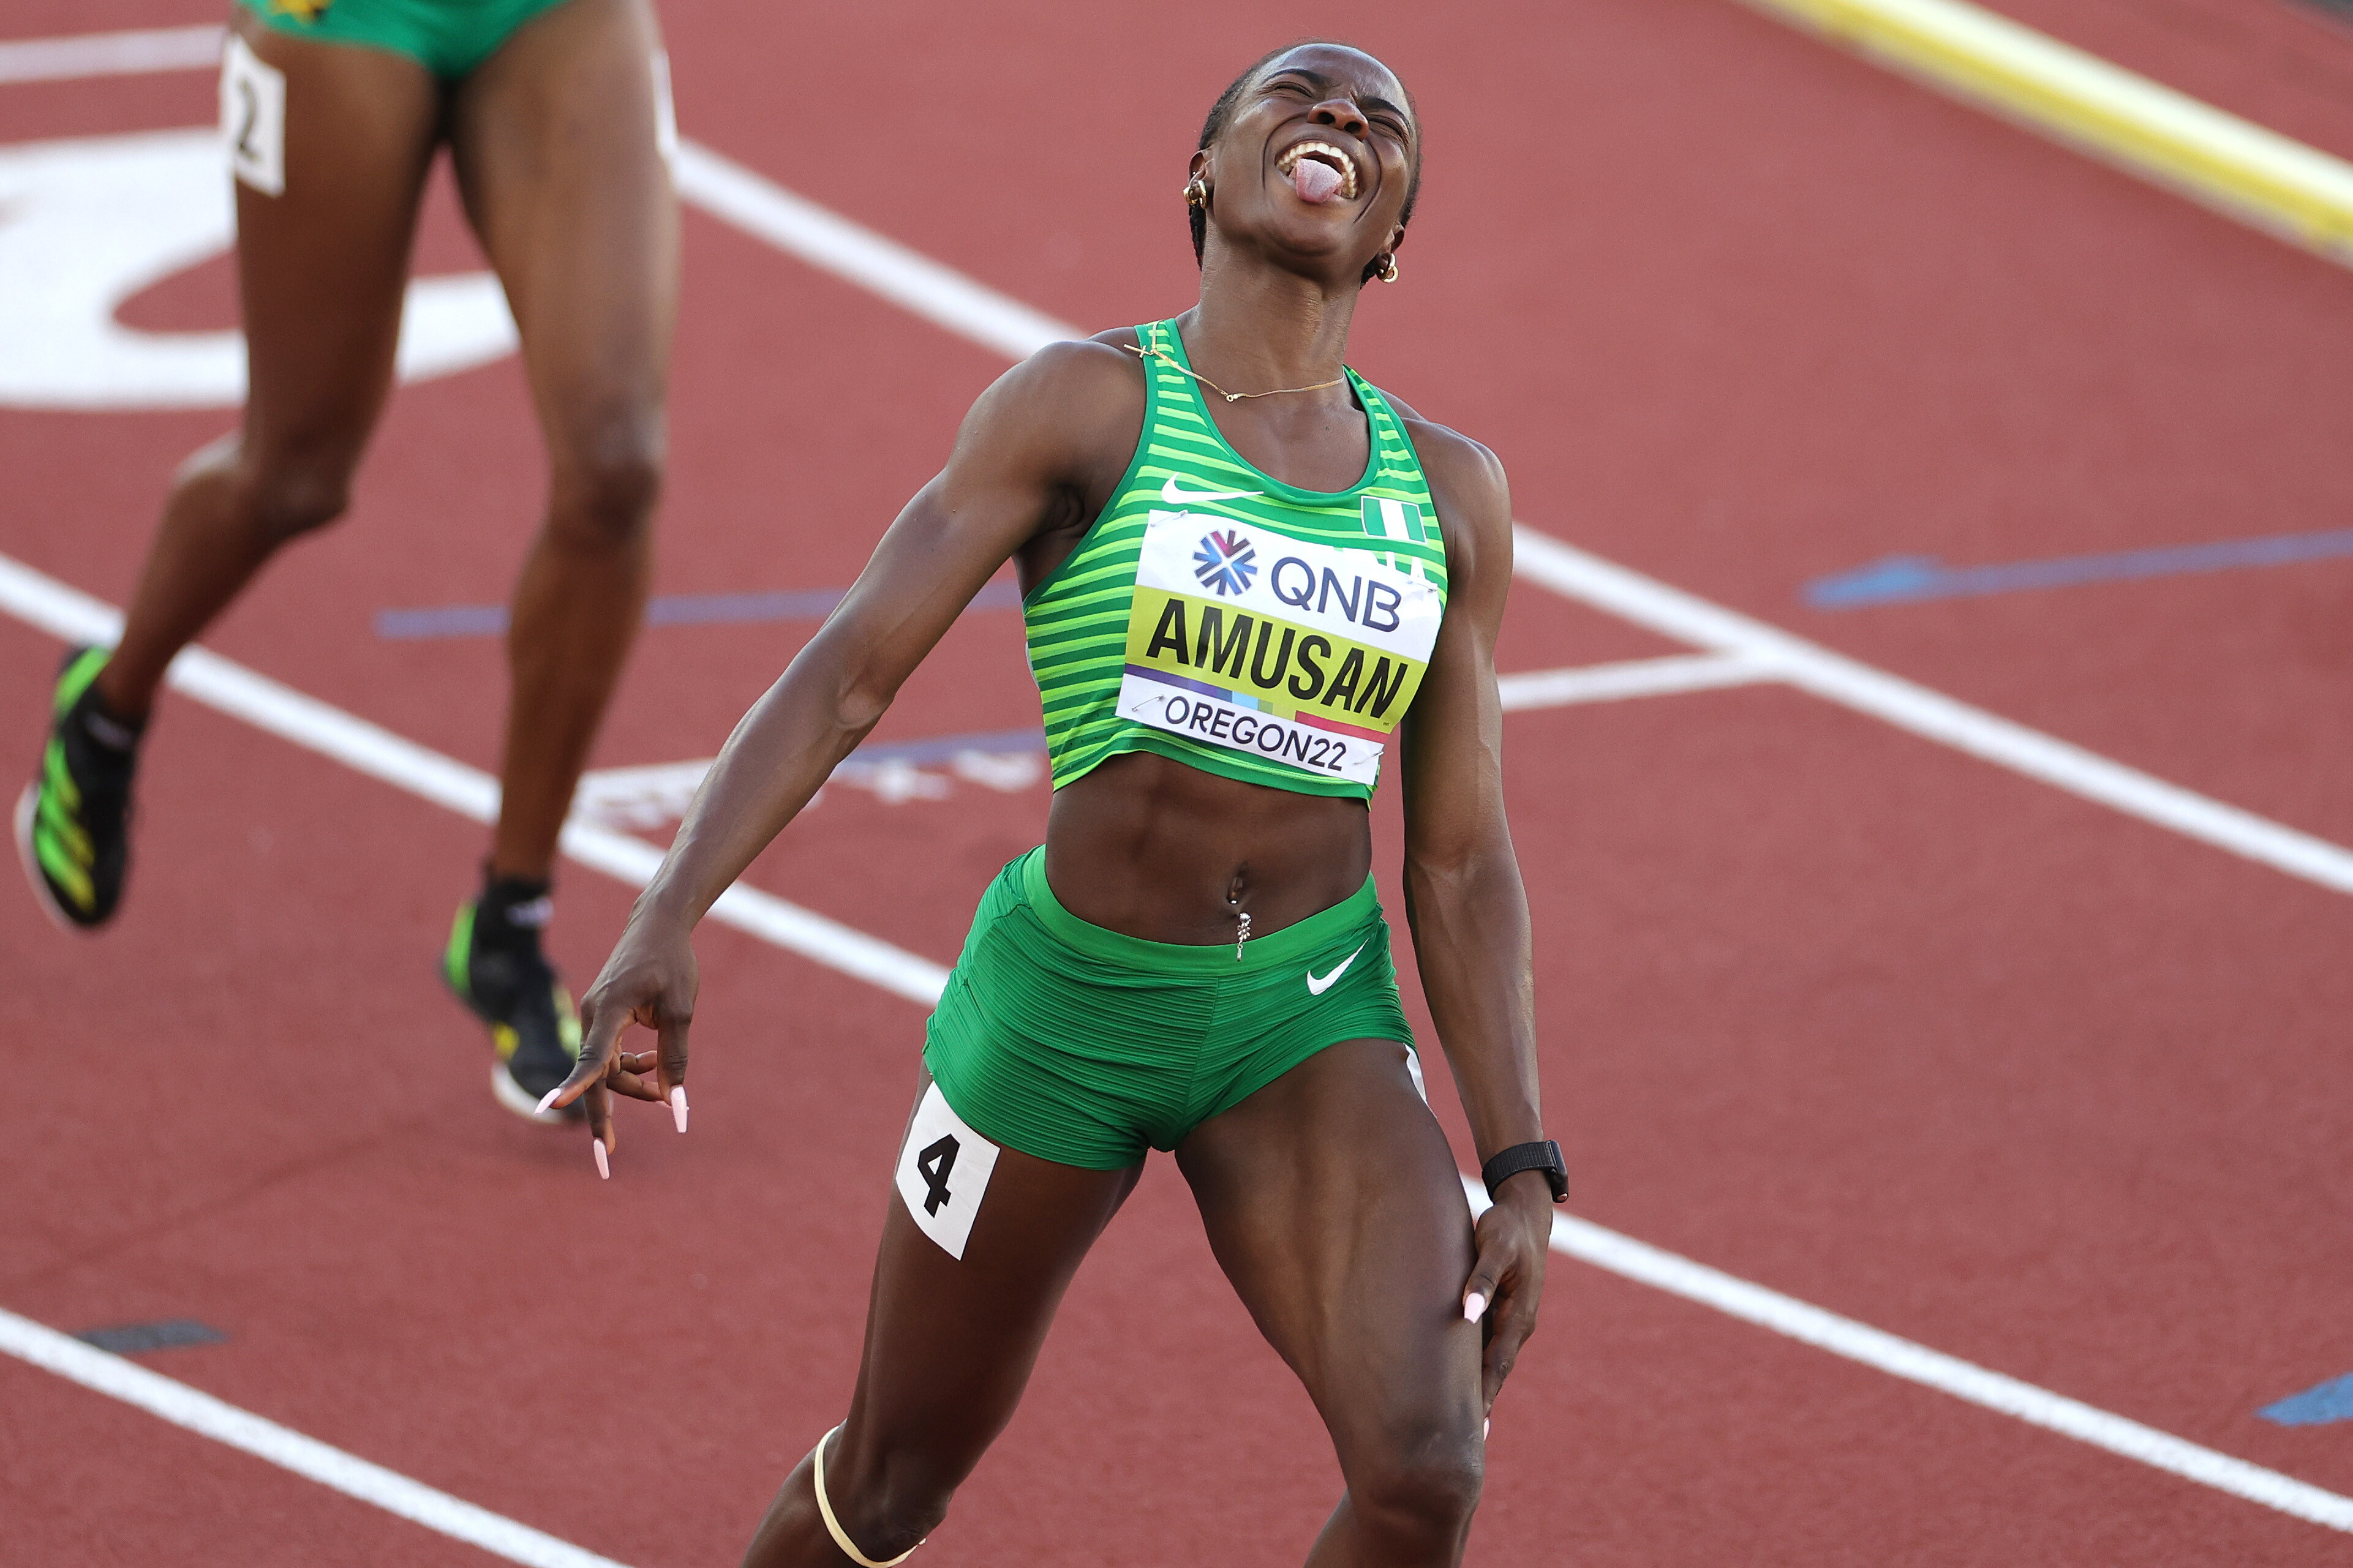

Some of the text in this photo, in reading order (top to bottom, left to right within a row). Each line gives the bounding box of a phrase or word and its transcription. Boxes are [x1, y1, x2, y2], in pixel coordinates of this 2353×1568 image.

[235, 75, 263, 164] 2
[1270, 557, 1402, 632] QNB
[1146, 598, 1408, 719] AMUSAN
[1165, 696, 1347, 771] OREGON22
[917, 1133, 960, 1218] 4
